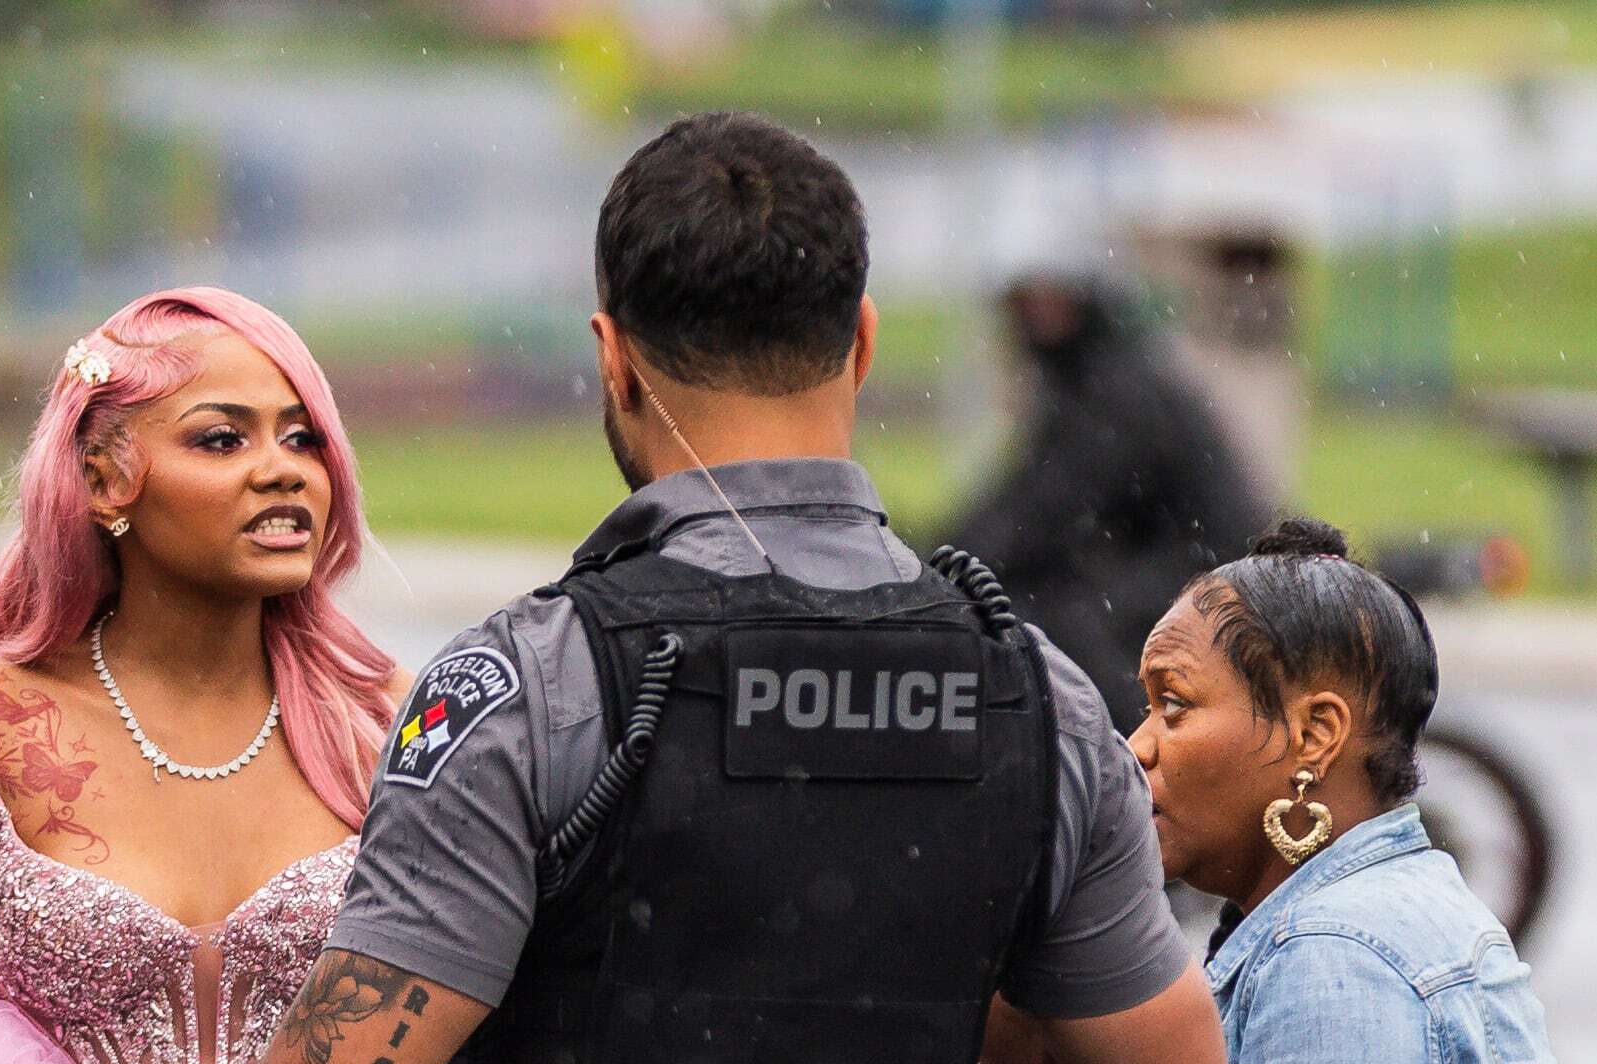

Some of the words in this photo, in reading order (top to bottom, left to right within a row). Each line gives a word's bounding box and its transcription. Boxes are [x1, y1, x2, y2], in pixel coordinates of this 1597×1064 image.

[426, 677, 481, 709] POLICE
[427, 656, 507, 698] STEELTON
[736, 668, 979, 731] POLICE
[398, 747, 419, 770] PA
